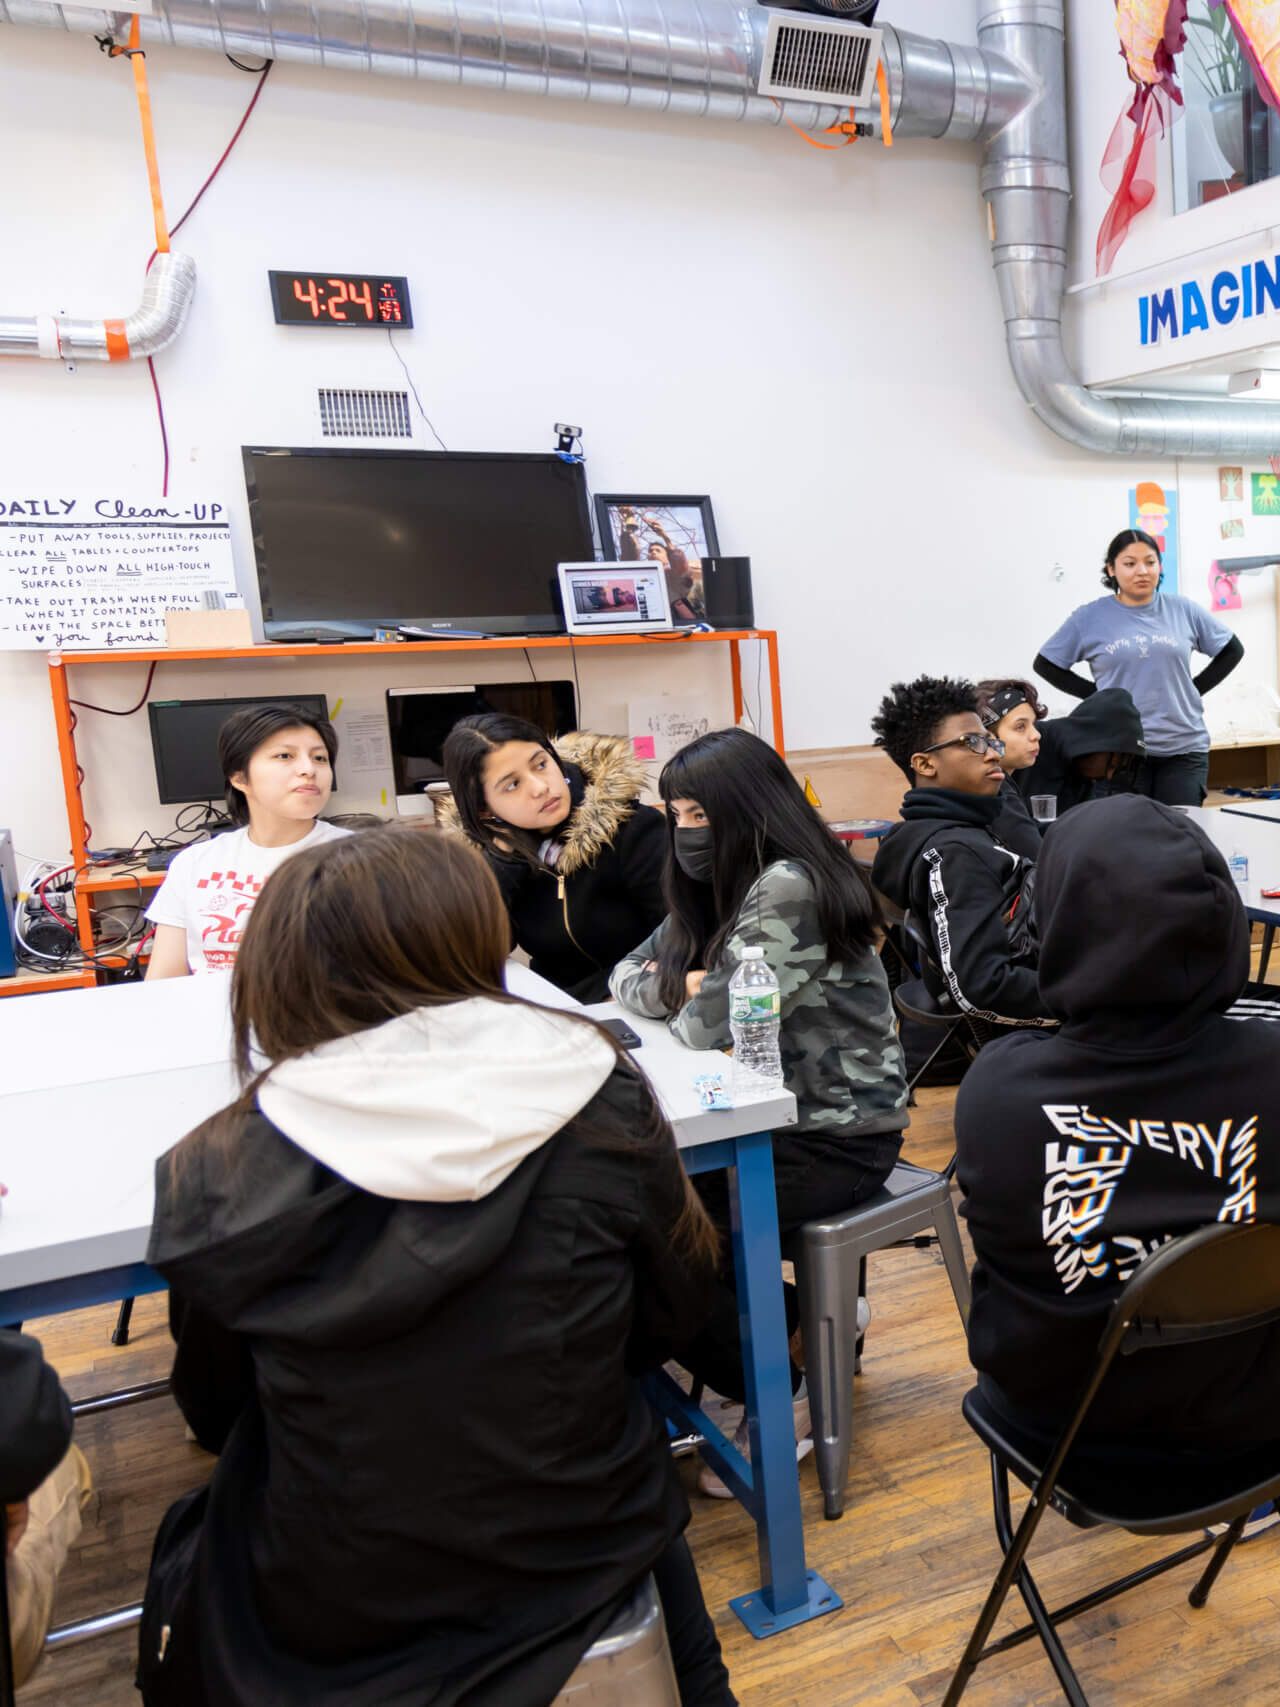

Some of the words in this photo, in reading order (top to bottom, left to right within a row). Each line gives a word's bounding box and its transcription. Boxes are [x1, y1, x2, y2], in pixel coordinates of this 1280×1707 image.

[293, 279, 374, 320] 4:24
[55, 534, 90, 542] AWAY
[122, 545, 200, 554] COUNTERTOPS
[66, 565, 107, 575] DOWN
[116, 563, 141, 571] ALL
[21, 579, 82, 589] SURFACES
[49, 598, 73, 606] OUT
[82, 595, 124, 605] TRASH
[130, 595, 167, 603] WHEN
[172, 594, 201, 603] FULL
[25, 610, 65, 619] WHEN
[71, 609, 85, 617] IT
[92, 606, 156, 616] CONTAINS
[15, 623, 51, 631] LEAVE
[59, 622, 81, 630] THE
[91, 620, 132, 630] SPACE
[140, 619, 166, 628] BETT
[53, 633, 91, 647] you
[104, 631, 159, 646] found
